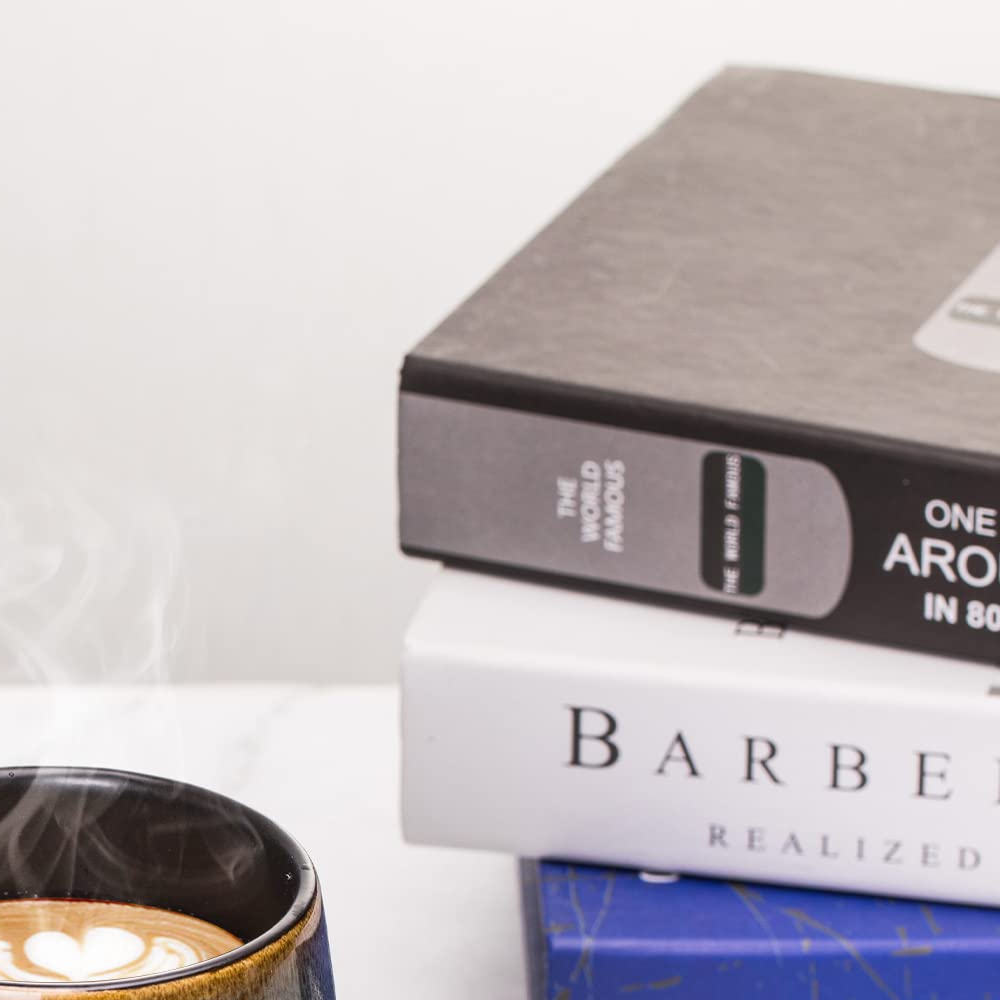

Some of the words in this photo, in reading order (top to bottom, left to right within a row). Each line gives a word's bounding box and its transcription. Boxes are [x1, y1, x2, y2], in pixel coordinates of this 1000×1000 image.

[557, 477, 578, 518] THE
[580, 460, 601, 542] WORLD
[603, 459, 625, 552] FAMOUS
[924, 498, 998, 537] ONE
[724, 513, 741, 562] WORLD
[882, 532, 1000, 588] ARO
[923, 591, 958, 624] IN
[965, 599, 1000, 632] 80
[562, 704, 1000, 805] BARBE
[706, 822, 981, 870] REALIZED
